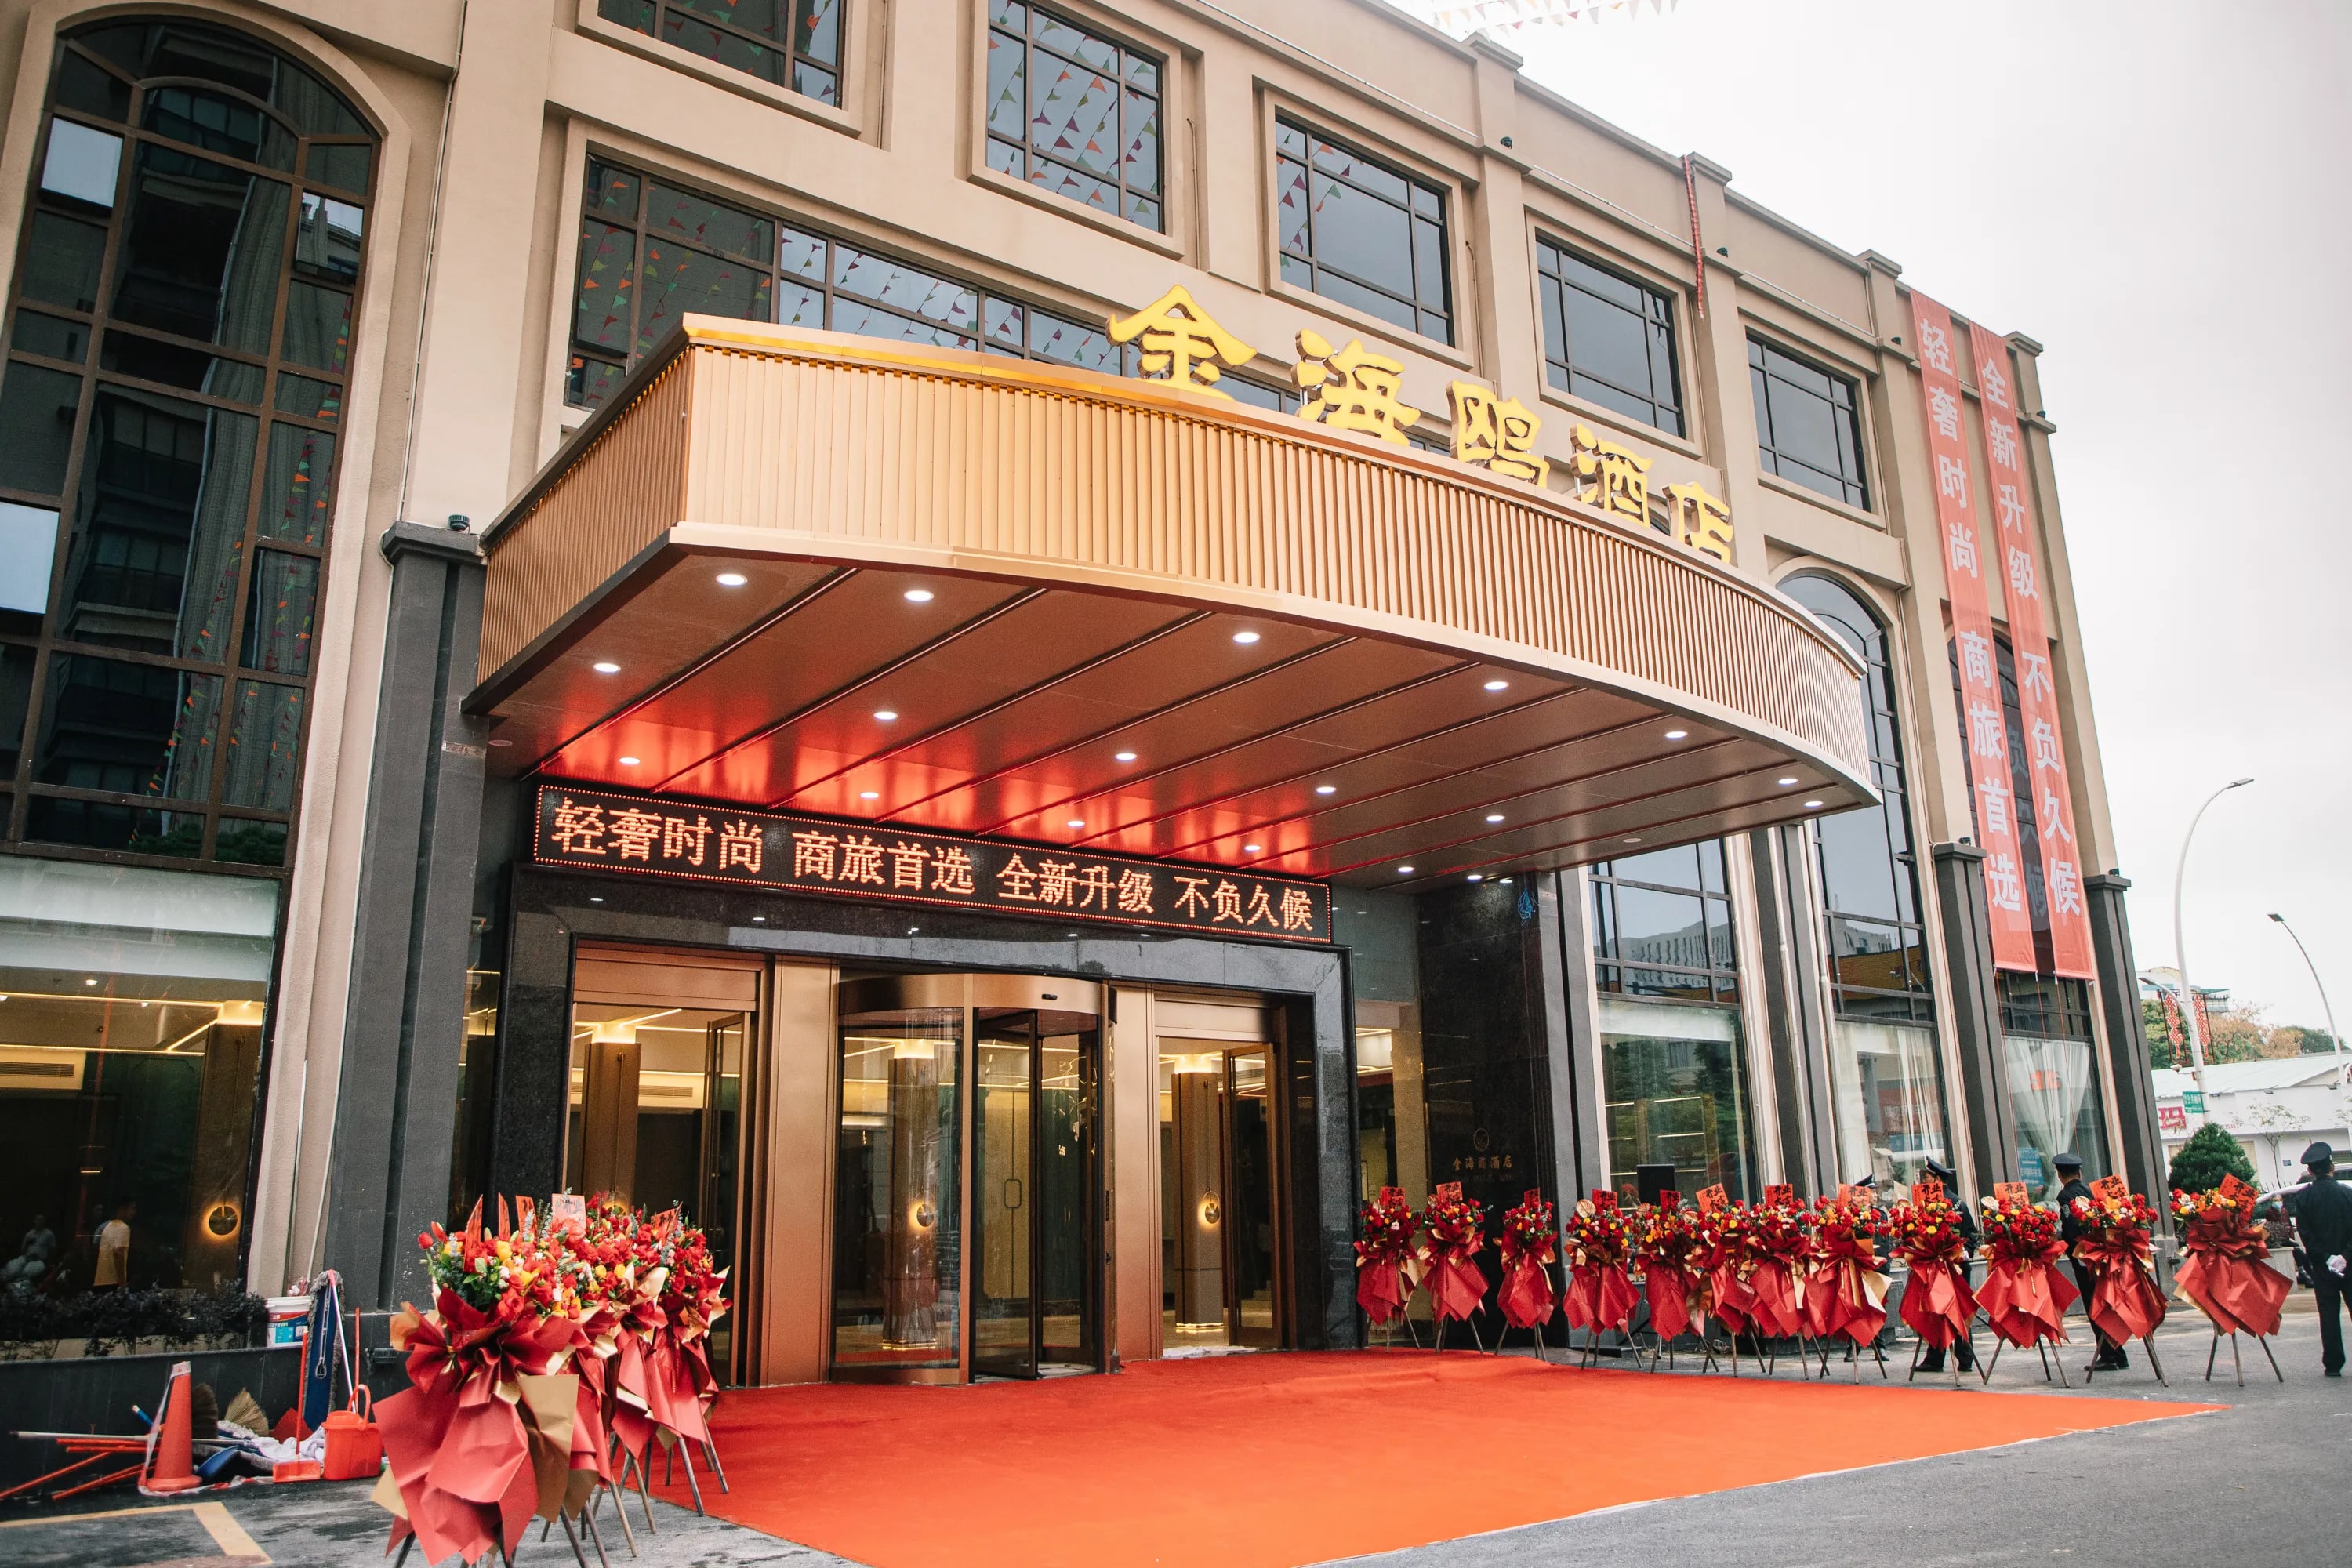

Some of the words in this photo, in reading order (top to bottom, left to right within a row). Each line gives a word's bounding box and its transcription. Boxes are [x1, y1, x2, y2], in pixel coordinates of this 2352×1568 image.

[1105, 284, 1733, 564] 金海鸥酒店
[1920, 318, 1978, 579] 轻奢时尚
[1960, 630, 2021, 913] 商旅首选
[1981, 358, 2038, 601] 全新升级
[2020, 651, 2082, 916] 不负久候
[550, 797, 764, 873] 轻奢时尚
[792, 829, 975, 895] 商旅首选
[996, 853, 1154, 915] 全新升级
[1173, 875, 1314, 932] 不负久候
